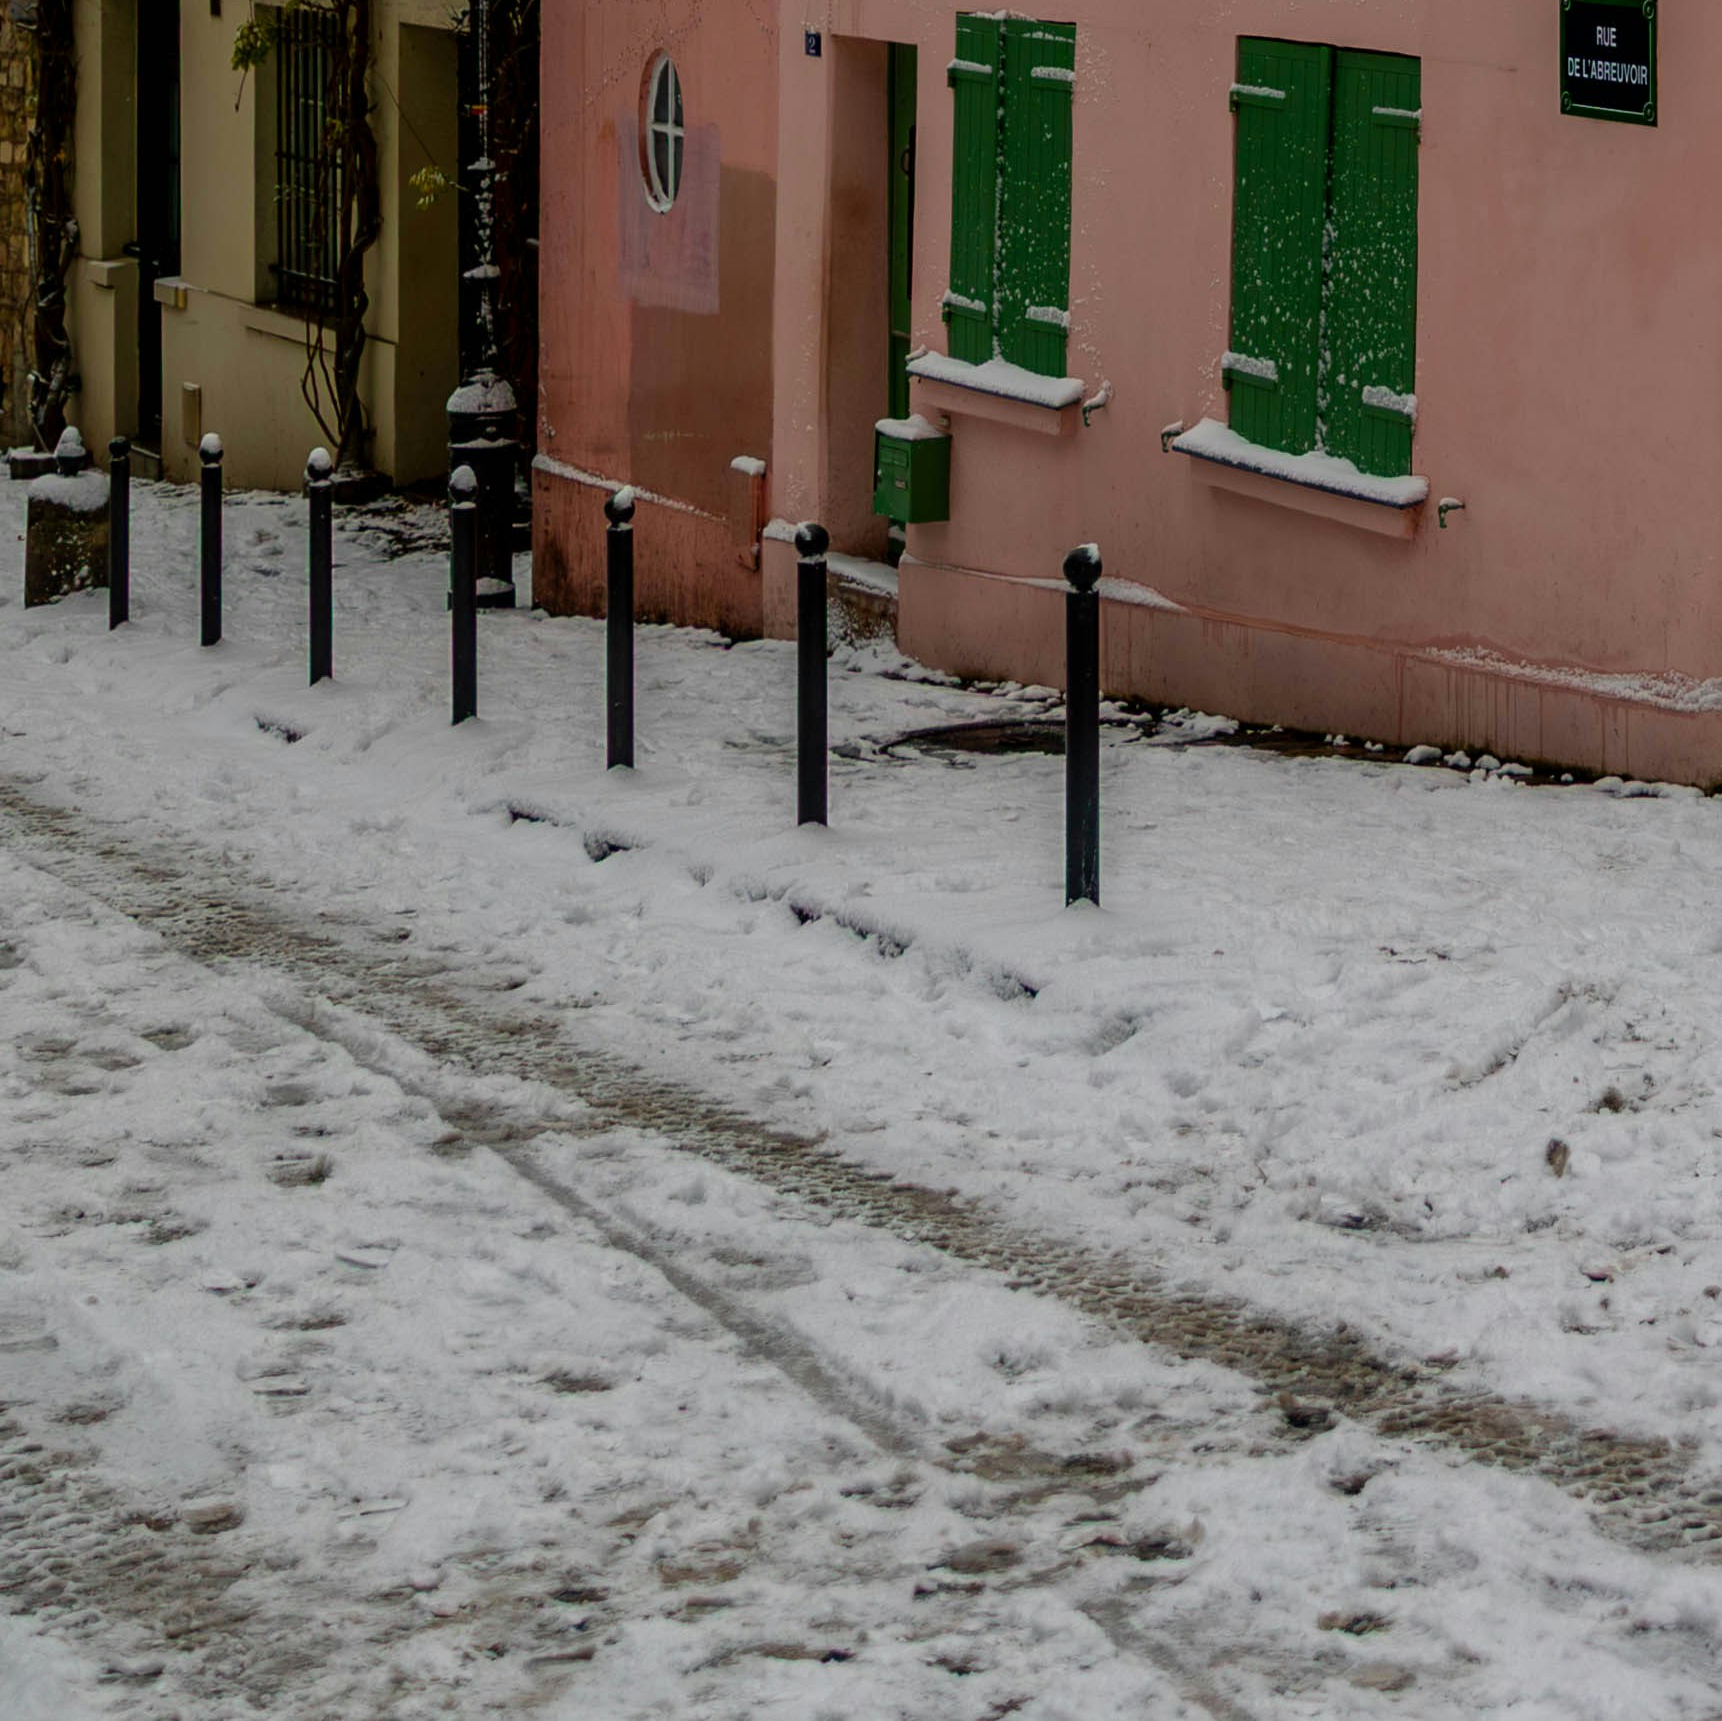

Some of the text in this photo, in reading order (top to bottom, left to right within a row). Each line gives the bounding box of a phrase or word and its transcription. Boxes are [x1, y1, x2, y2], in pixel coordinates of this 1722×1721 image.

[1596, 26, 1617, 47] RUE
[1567, 57, 1648, 85] DE L'ABREUVOIR
